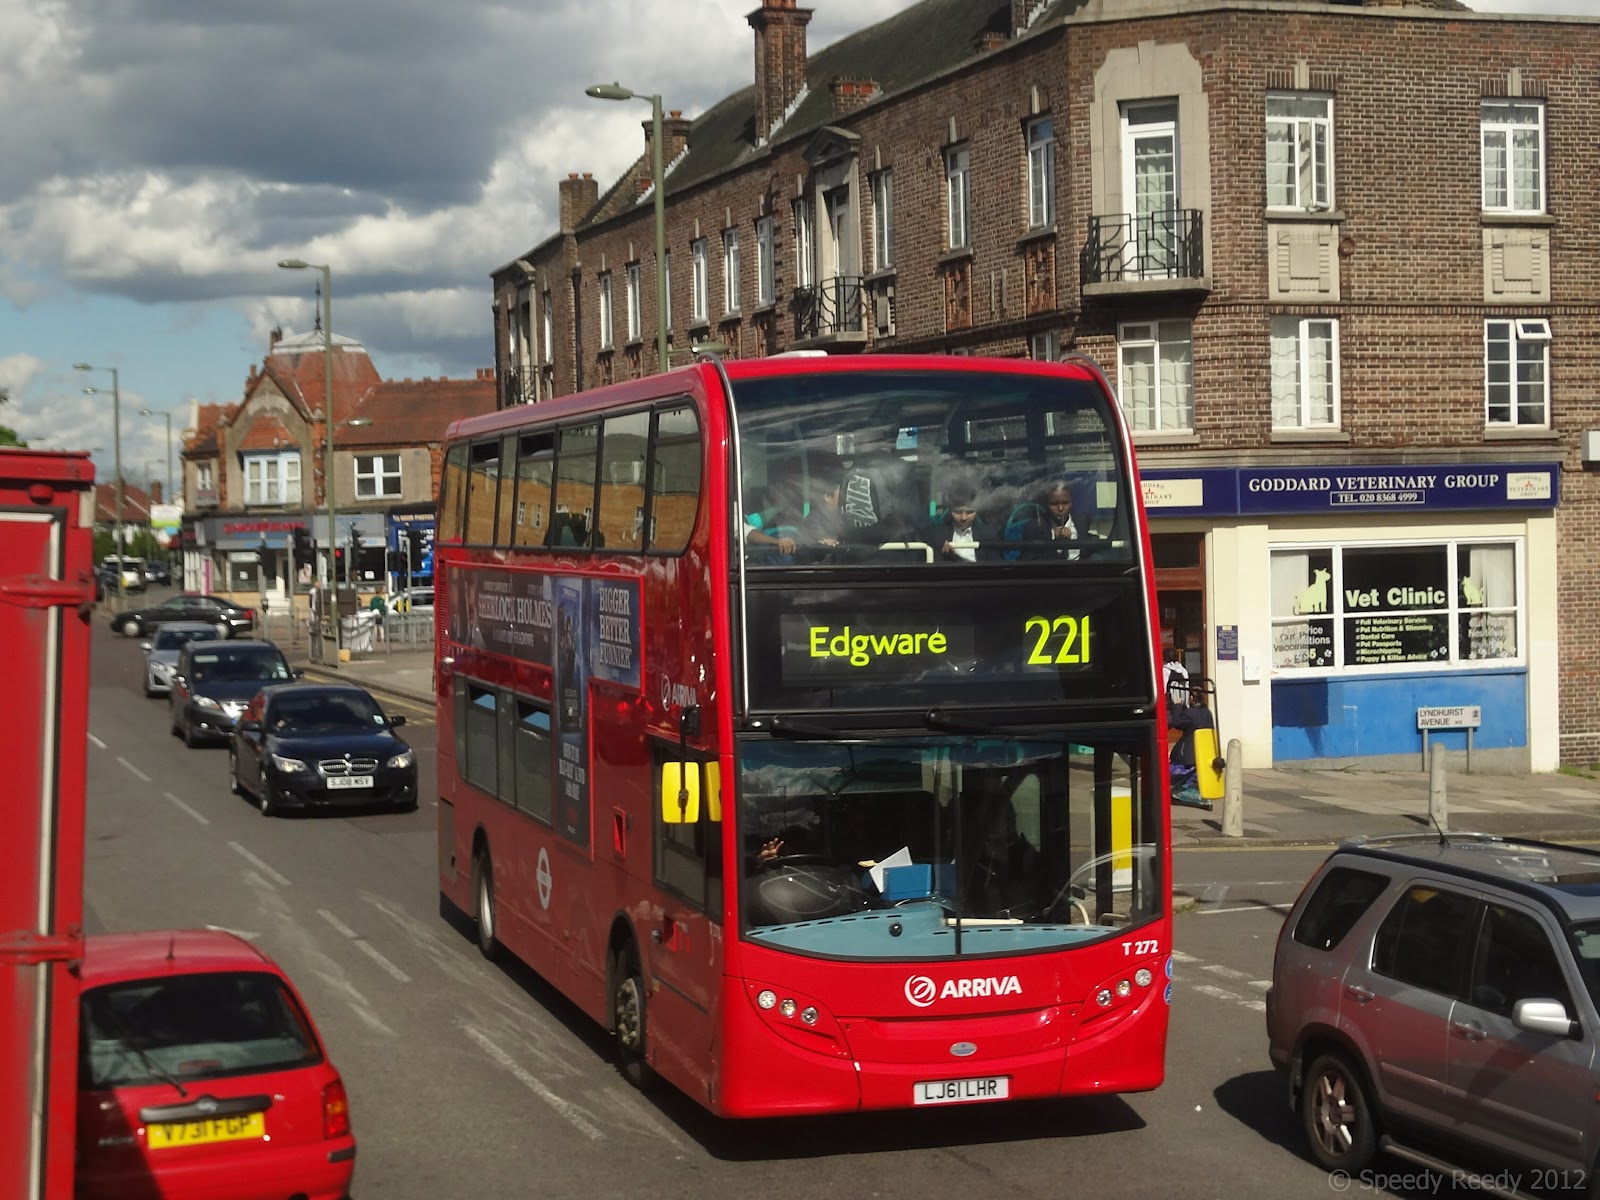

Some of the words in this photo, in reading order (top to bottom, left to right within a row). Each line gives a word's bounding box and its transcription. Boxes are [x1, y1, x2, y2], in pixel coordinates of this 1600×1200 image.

[1248, 478, 1331, 492] GODDARD
[1336, 475, 1437, 490] VETERINARY
[1444, 474, 1499, 488] GROUP
[1338, 493, 1358, 503] TEL.
[1360, 493, 1375, 502] 020
[1376, 493, 1396, 502] 8368
[1398, 492, 1418, 502] 4999
[599, 587, 631, 615] BIGGER
[1345, 589, 1379, 607] Vet
[1387, 586, 1446, 606] Clinic
[517, 597, 553, 629] HOLMES
[599, 614, 632, 644] BETTER
[810, 626, 947, 666] Edgware
[1025, 615, 1090, 665] 221
[600, 642, 632, 669] FUNNIER
[1420, 708, 1464, 717] LYNDHURST
[1420, 718, 1450, 726] AVENUE
[1122, 942, 1132, 956] T
[1135, 940, 1159, 955] 272
[940, 975, 1022, 999] ARRIVA
[924, 1082, 961, 1099] LJ61
[966, 1079, 997, 1097] LHR
